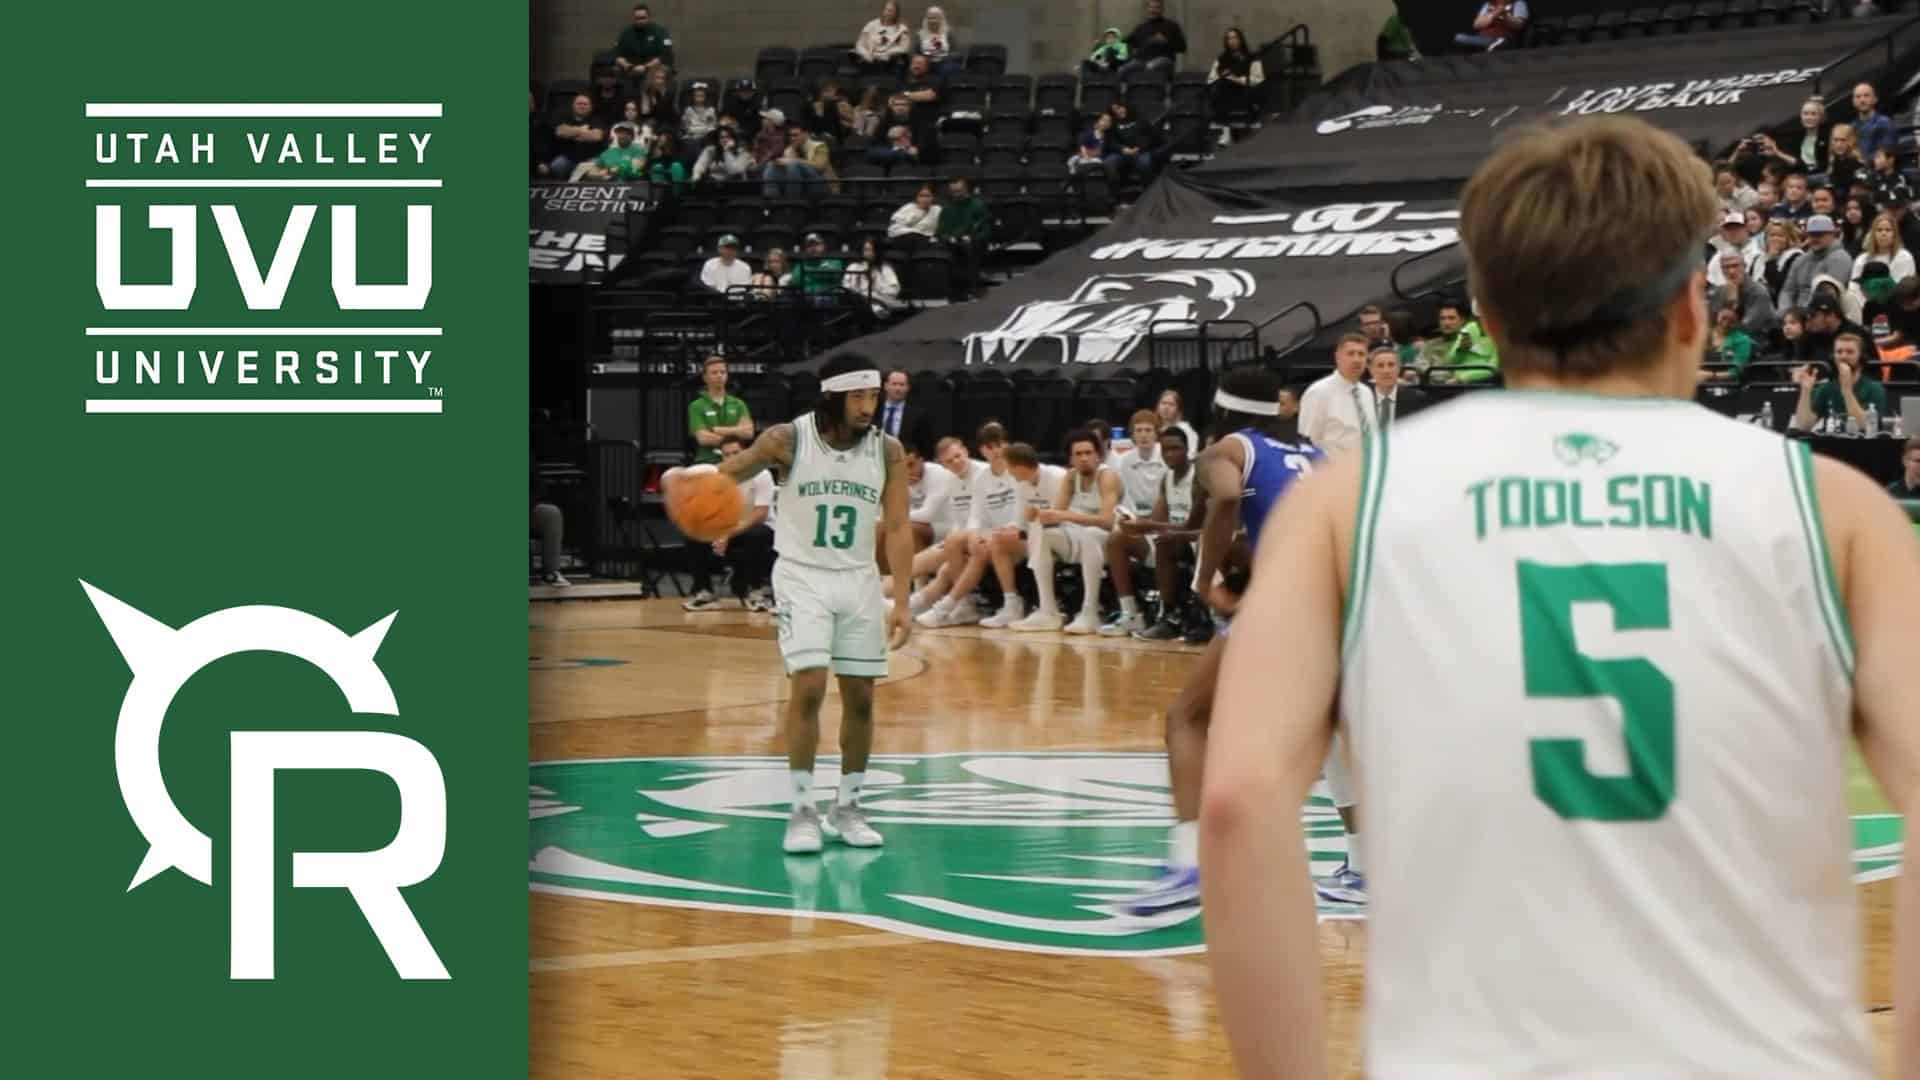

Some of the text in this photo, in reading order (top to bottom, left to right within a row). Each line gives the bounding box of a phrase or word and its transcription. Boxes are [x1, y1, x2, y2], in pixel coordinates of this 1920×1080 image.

[1292, 201, 1405, 232] GO
[798, 479, 880, 505] WOLVERINES
[1465, 474, 1712, 542] TOOLSON
[813, 503, 857, 549] 13
[1516, 560, 1677, 822] 5
